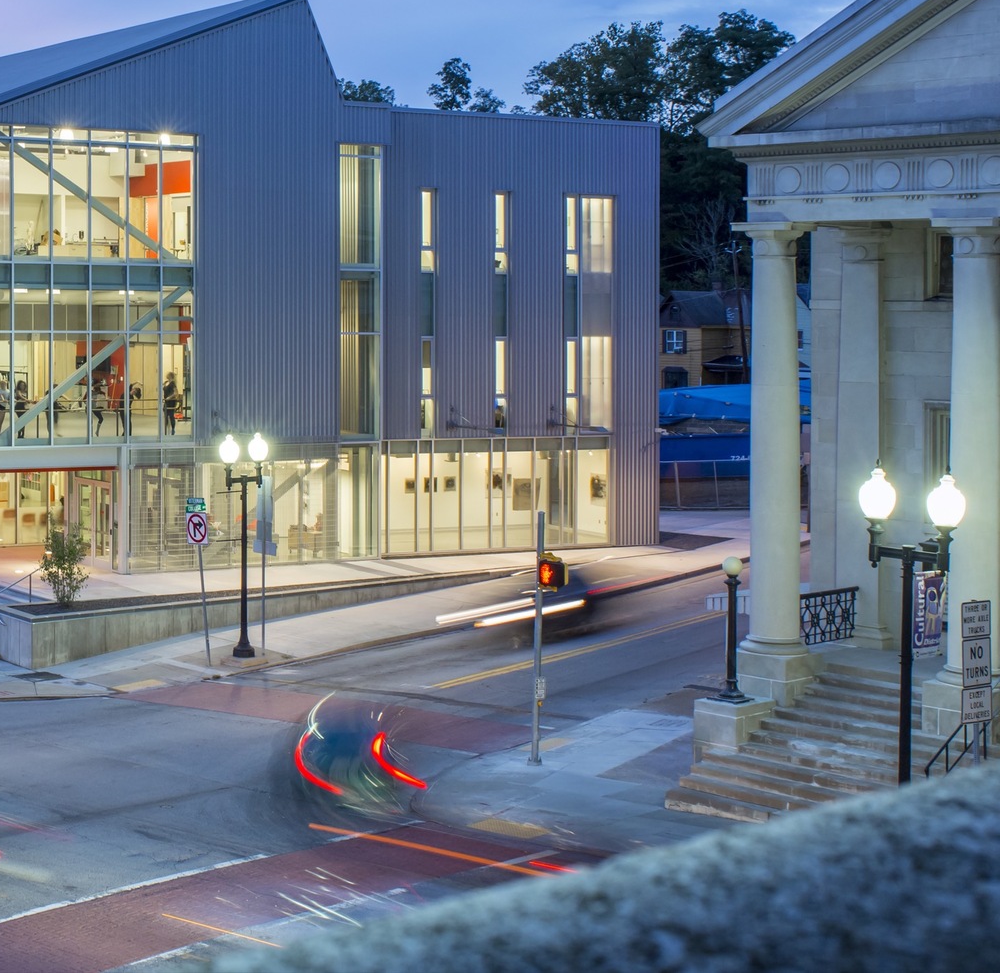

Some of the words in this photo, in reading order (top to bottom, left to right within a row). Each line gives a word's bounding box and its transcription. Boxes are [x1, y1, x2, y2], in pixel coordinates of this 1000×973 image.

[914, 575, 926, 646] Cultural
[965, 605, 980, 613] THREE
[981, 603, 988, 611] OR
[963, 616, 976, 624] MORE
[968, 626, 985, 634] TRUCKS
[970, 645, 984, 660] NO
[965, 666, 989, 679] TURNS
[969, 690, 986, 699] EXCEPT
[970, 701, 984, 709] LOCAL
[964, 710, 990, 720] DELIVERIES
